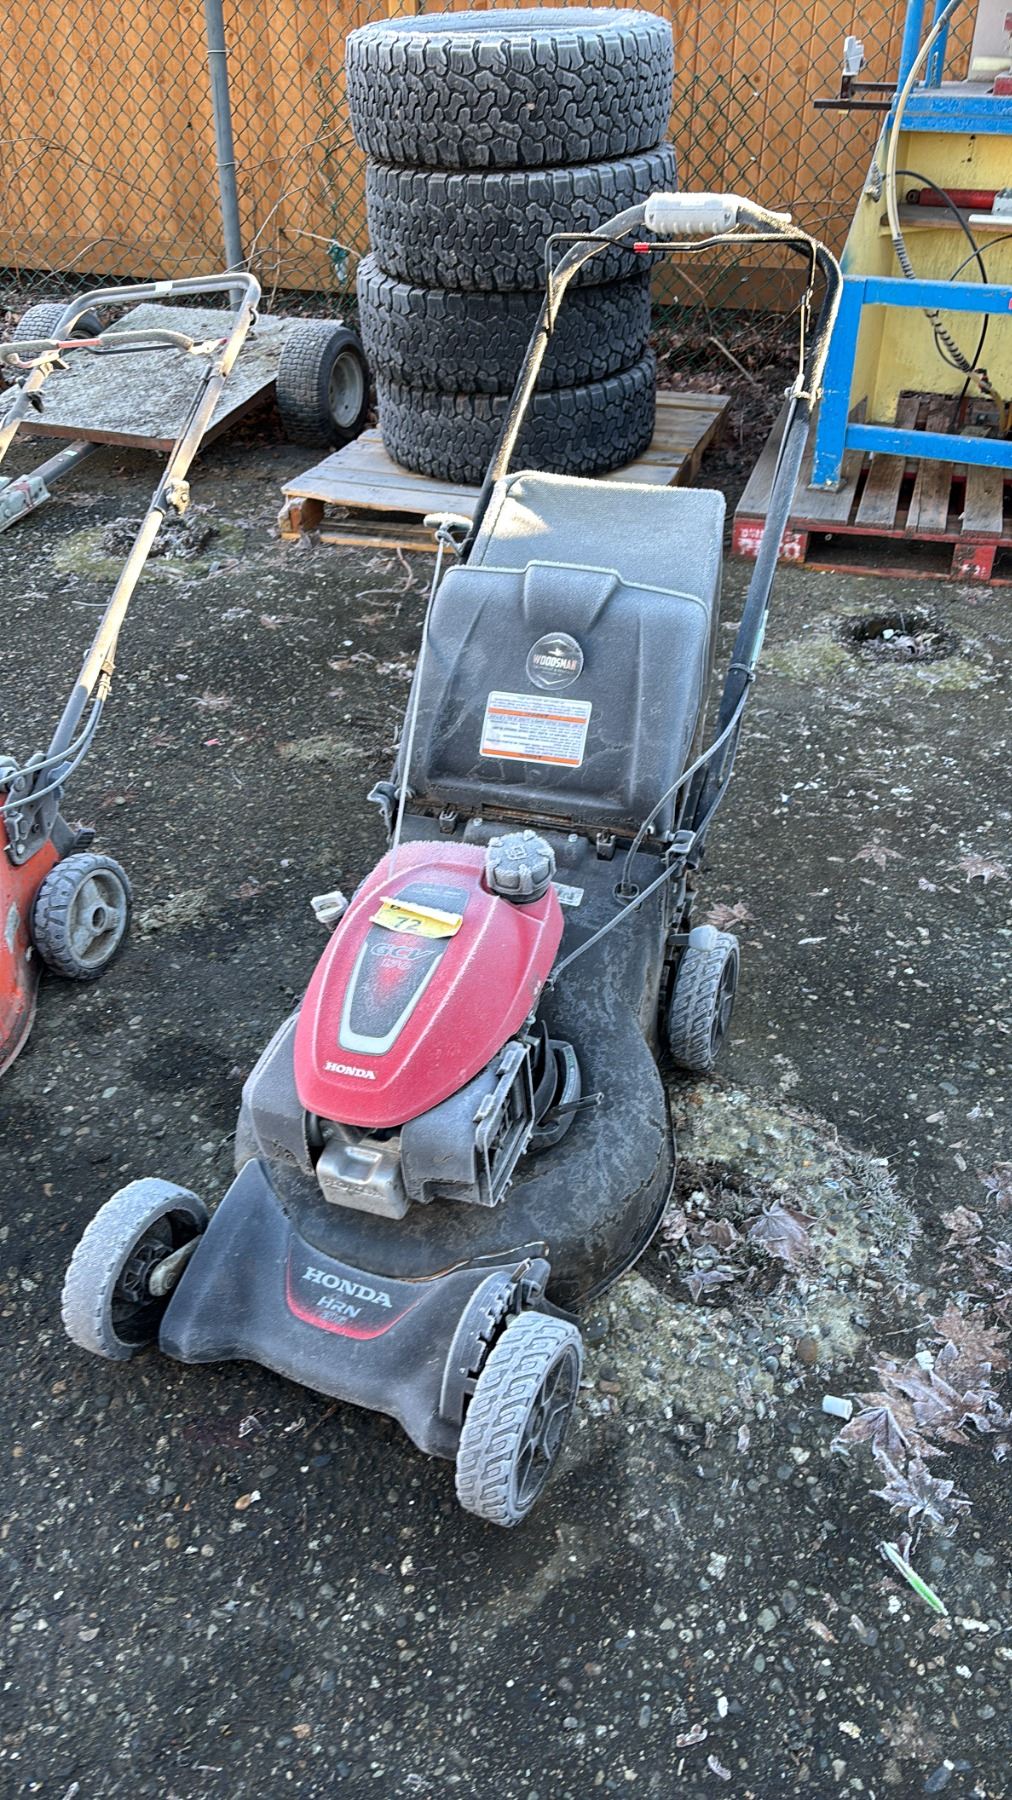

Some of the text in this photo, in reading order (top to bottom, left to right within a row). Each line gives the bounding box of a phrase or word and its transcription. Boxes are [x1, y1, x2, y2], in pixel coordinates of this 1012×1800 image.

[738, 538, 801, 558] PO
[532, 654, 578, 671] WOODSMAN
[394, 916, 422, 931] 72
[369, 942, 437, 961] GCV
[324, 1061, 376, 1080] HONDA
[302, 1266, 393, 1308] HONDA
[316, 1295, 362, 1318] HRN
